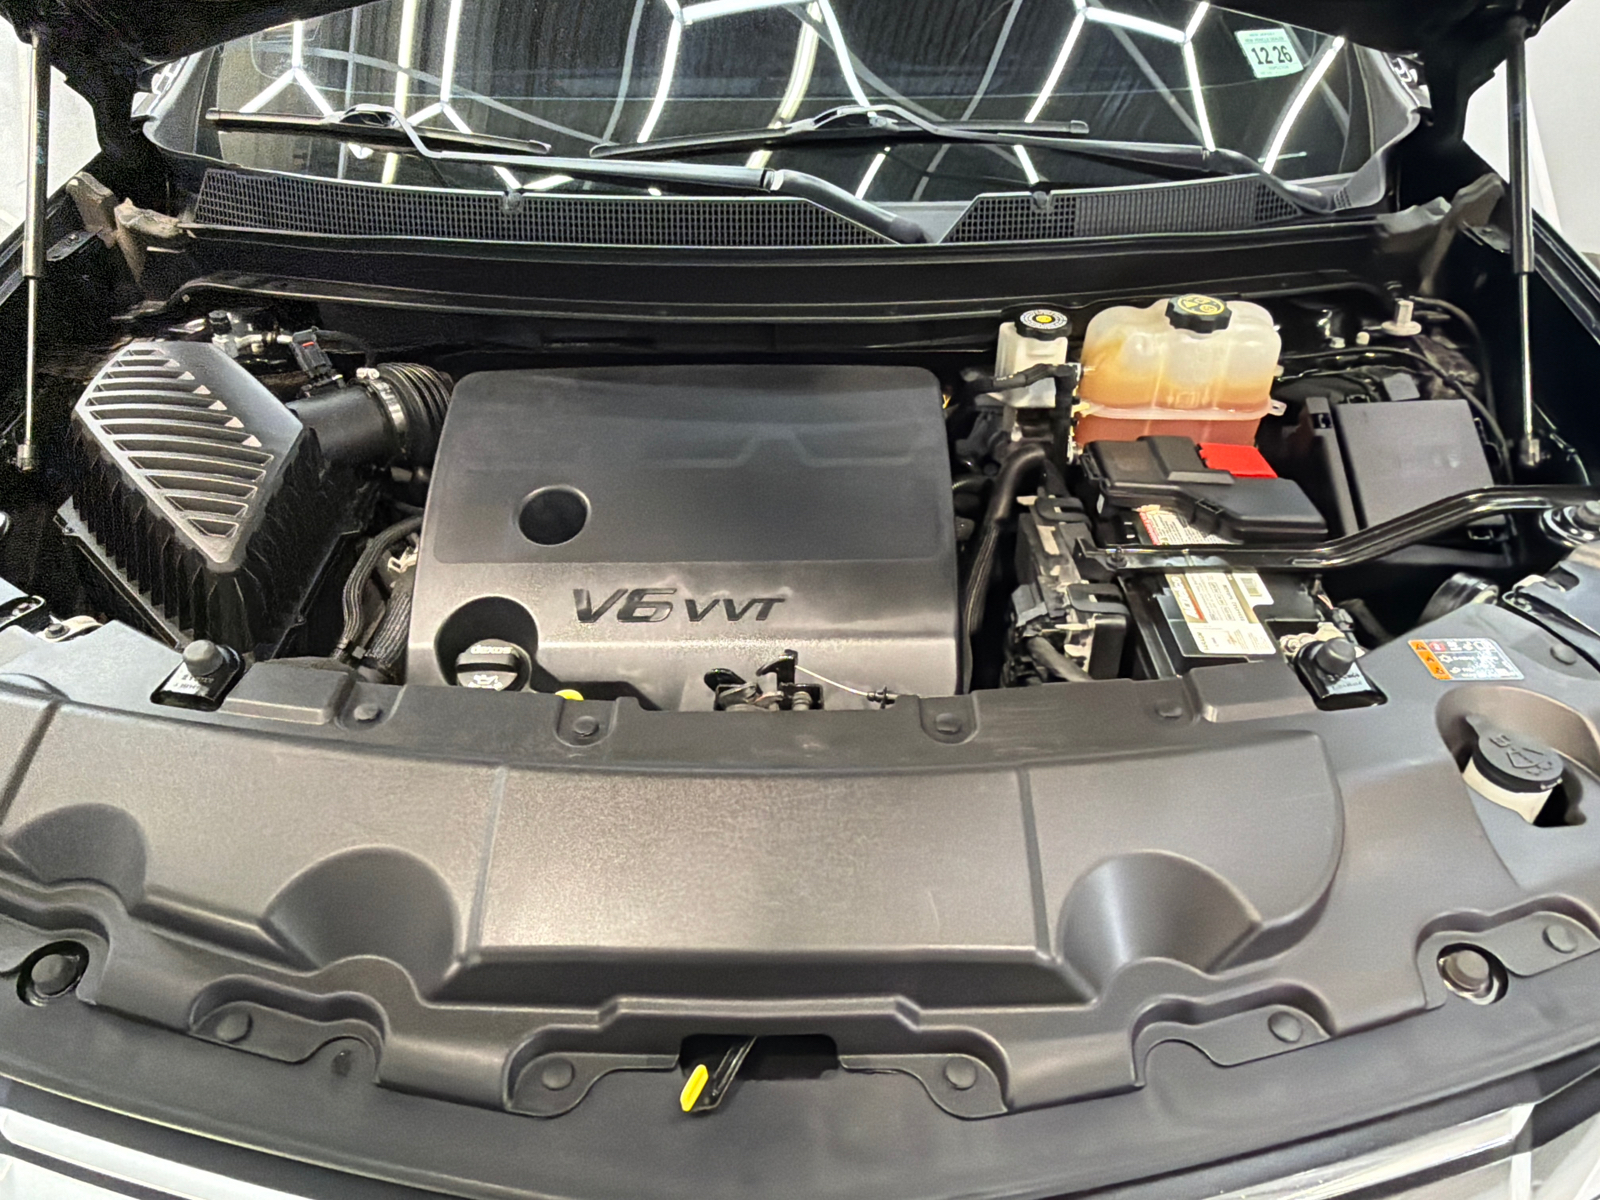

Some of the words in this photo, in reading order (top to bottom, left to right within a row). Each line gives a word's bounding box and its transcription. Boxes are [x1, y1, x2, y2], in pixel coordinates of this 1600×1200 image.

[1251, 47, 1274, 65] 12
[1272, 45, 1293, 63] 26
[573, 588, 678, 623] V6
[685, 598, 786, 622] VVT
